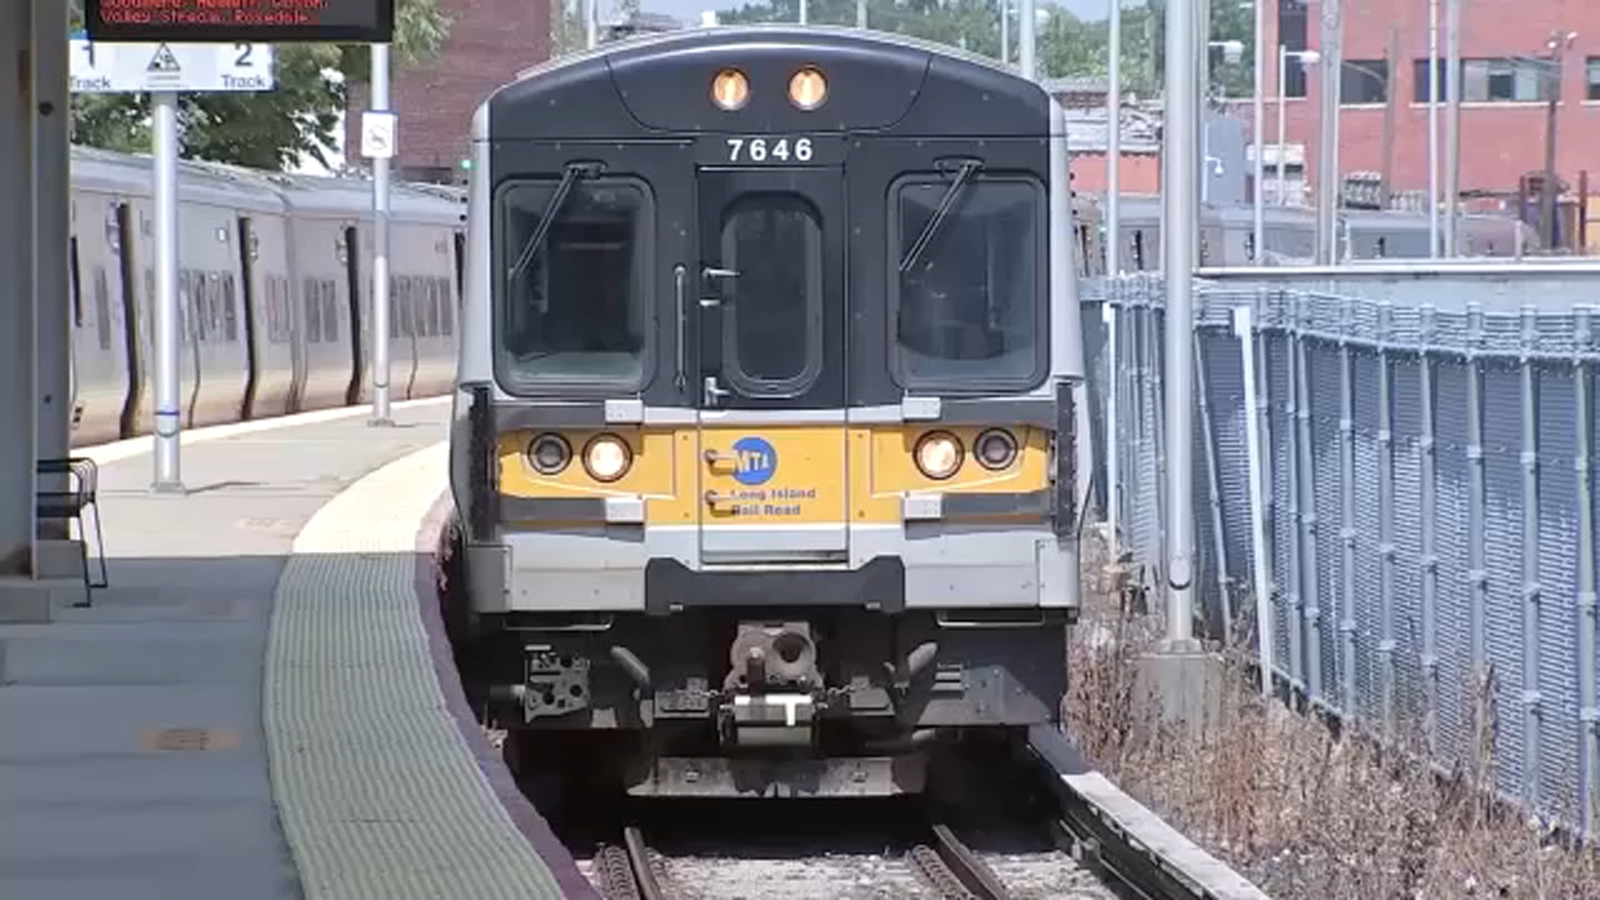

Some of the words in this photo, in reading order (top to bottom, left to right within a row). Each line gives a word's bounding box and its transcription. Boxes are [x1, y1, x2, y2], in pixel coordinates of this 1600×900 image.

[82, 41, 95, 69] 1
[235, 42, 253, 67] 2
[221, 74, 266, 88] Track
[727, 138, 812, 161] 7646
[735, 450, 770, 473] MTA
[772, 488, 815, 498] Island
[765, 504, 800, 515] Road
